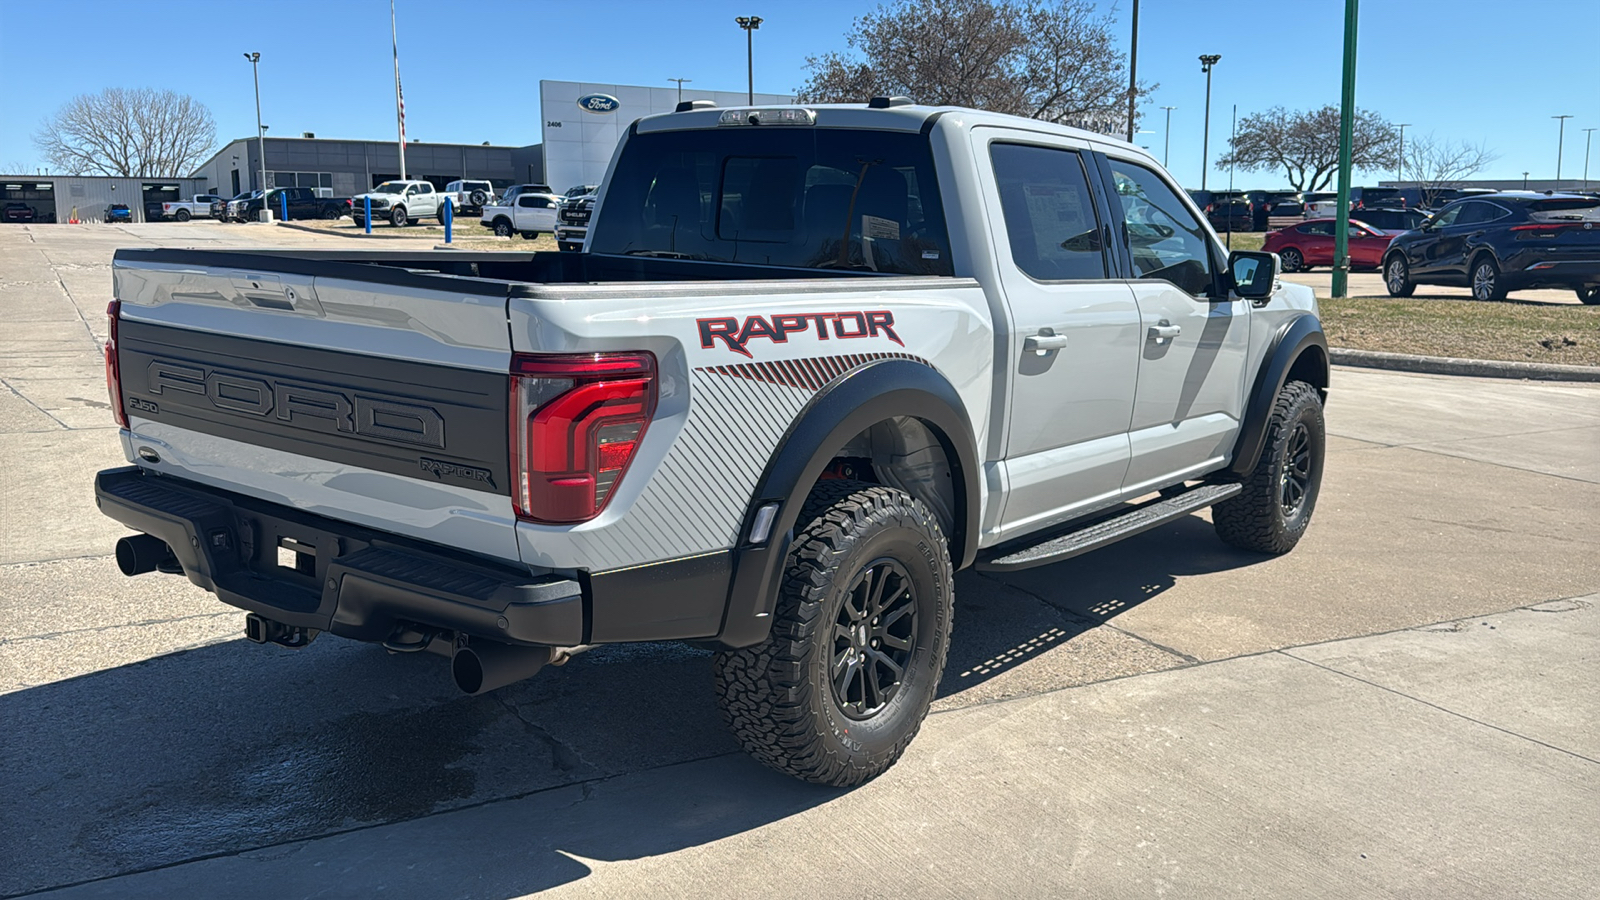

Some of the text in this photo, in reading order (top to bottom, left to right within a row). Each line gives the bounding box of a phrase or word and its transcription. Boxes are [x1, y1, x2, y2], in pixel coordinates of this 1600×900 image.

[587, 97, 613, 110] Ford
[696, 310, 906, 360] RAPTOR
[146, 359, 446, 450] FORD
[420, 456, 498, 490] RAPTOR
